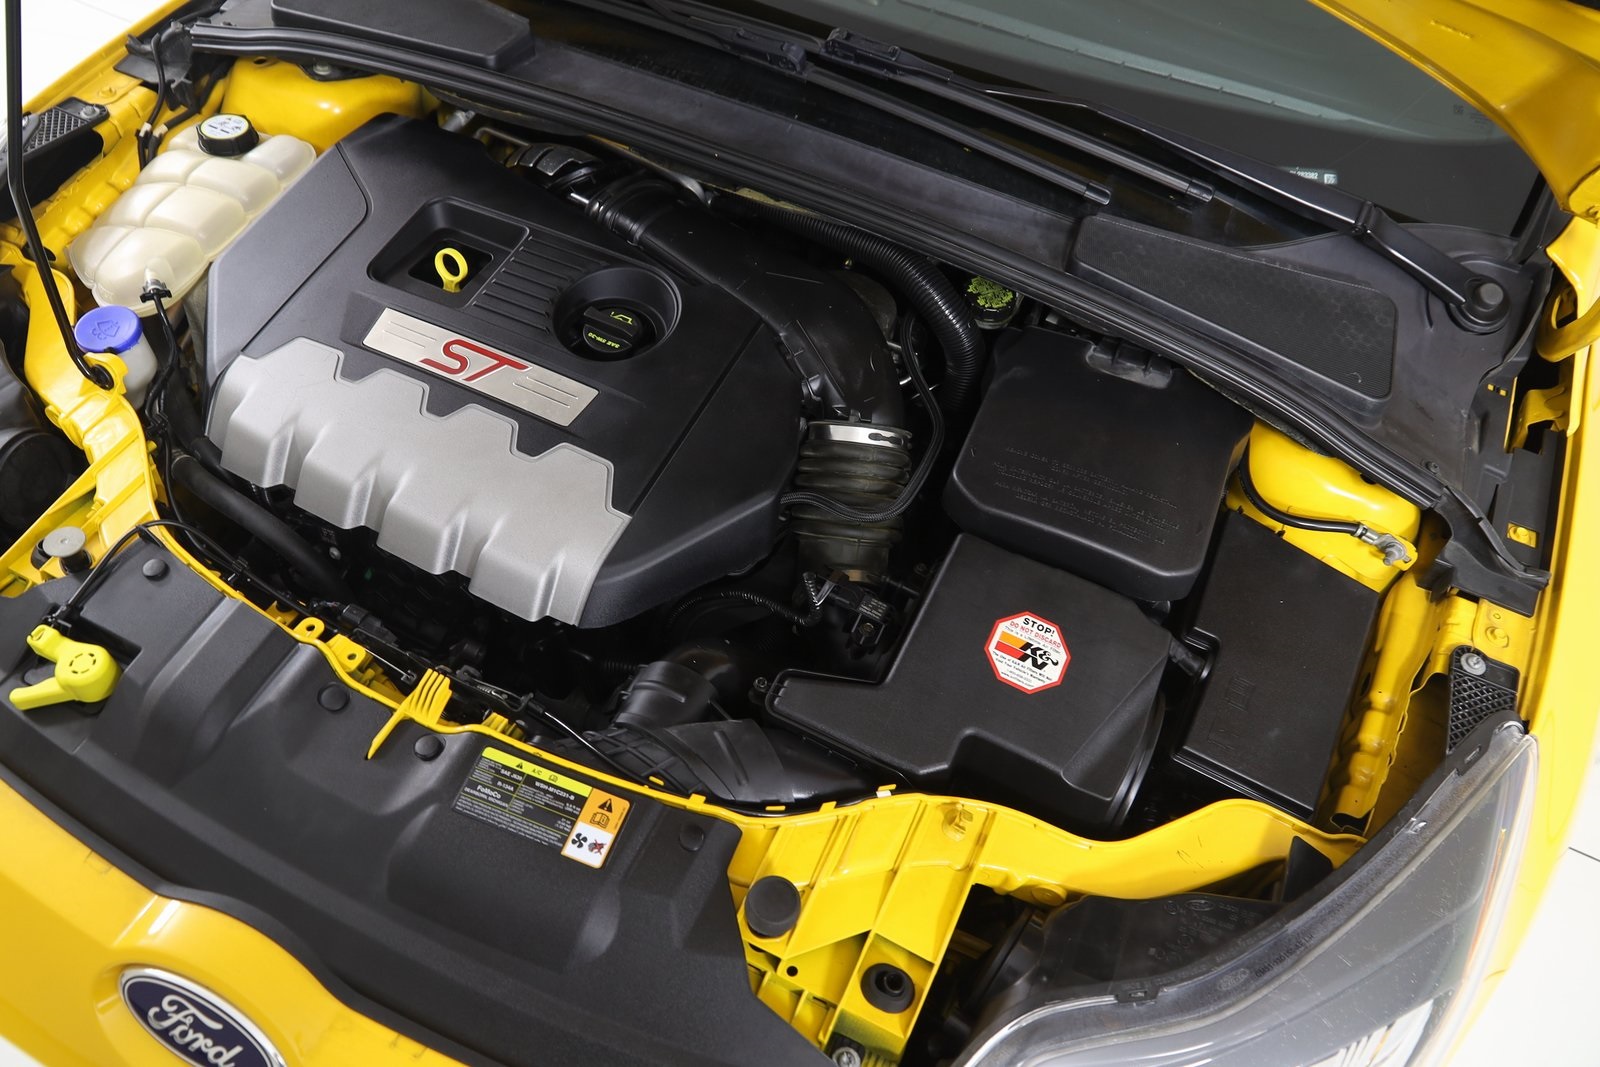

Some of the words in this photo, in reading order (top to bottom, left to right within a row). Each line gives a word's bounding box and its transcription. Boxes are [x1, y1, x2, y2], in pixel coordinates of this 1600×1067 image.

[418, 338, 530, 382] ST
[1020, 626, 1033, 634] NOT
[1034, 632, 1061, 648] DISCARD
[1023, 617, 1055, 637] STOP!
[1017, 641, 1059, 670] K&N
[476, 784, 502, 799] FoMoCo
[147, 994, 243, 1067] Ford
